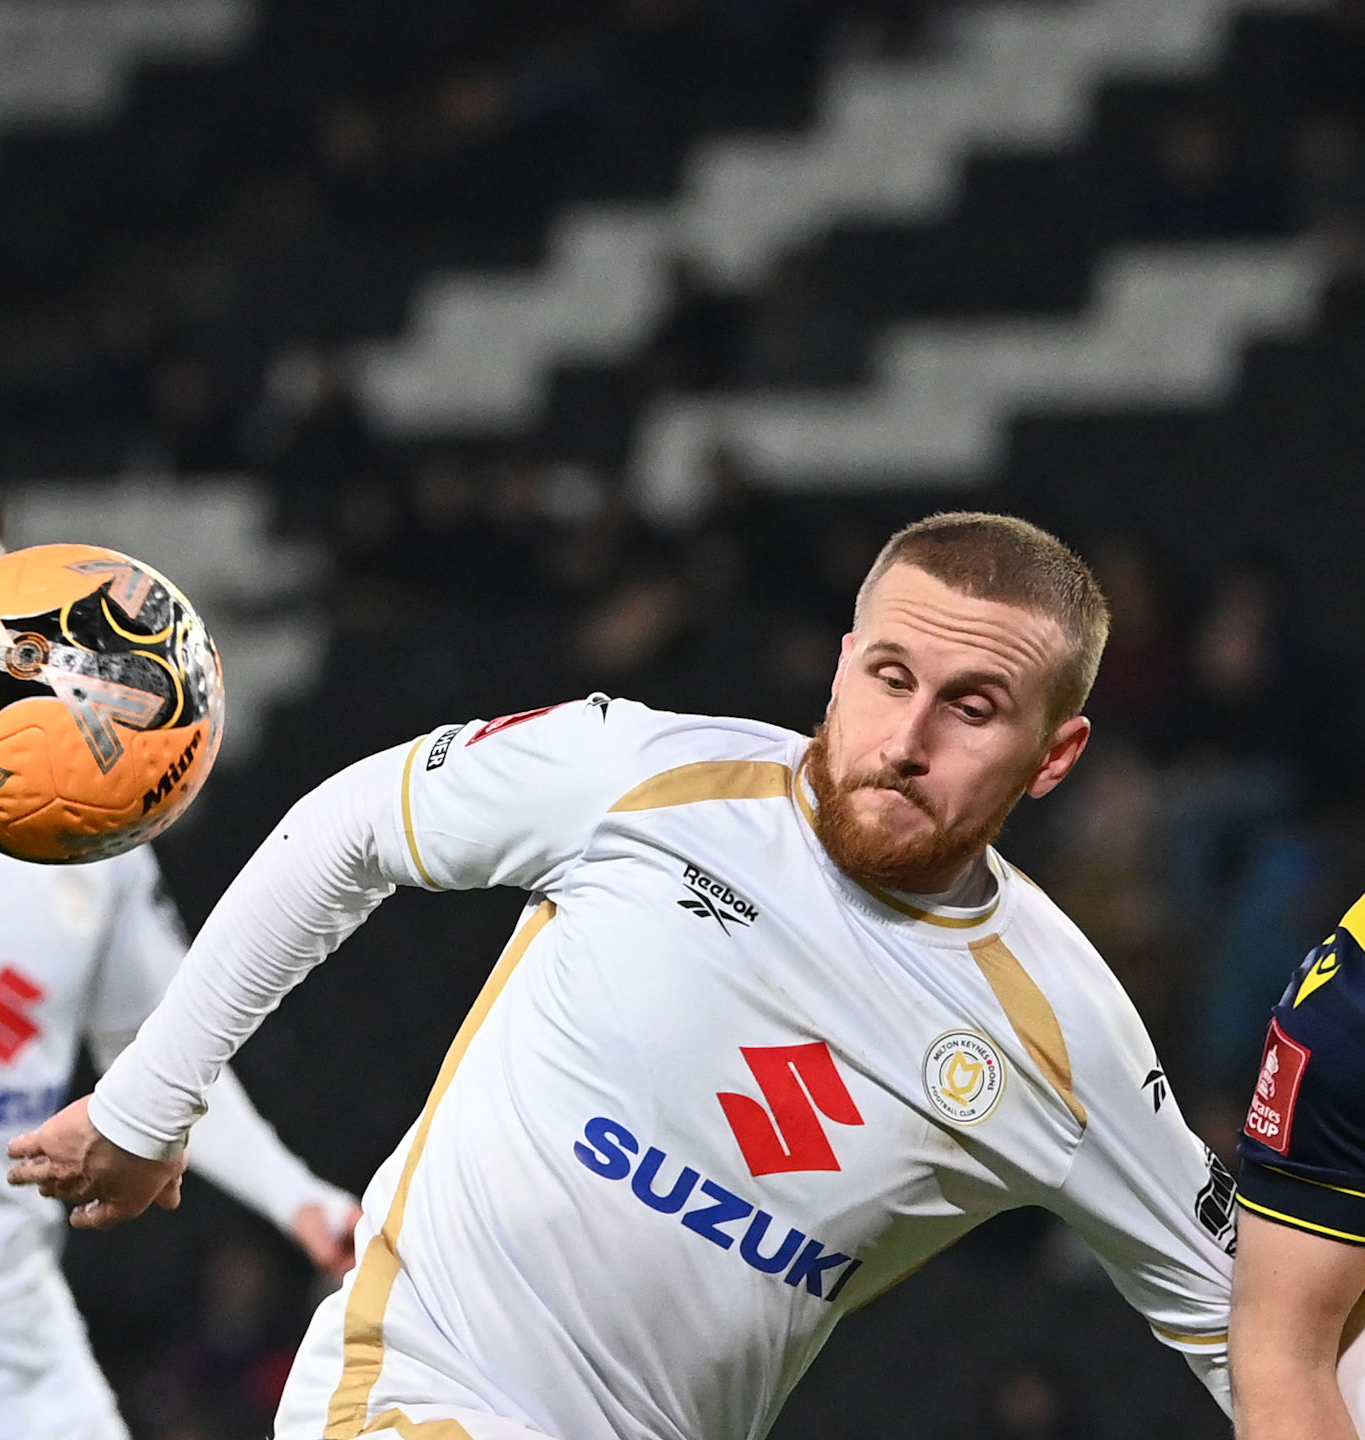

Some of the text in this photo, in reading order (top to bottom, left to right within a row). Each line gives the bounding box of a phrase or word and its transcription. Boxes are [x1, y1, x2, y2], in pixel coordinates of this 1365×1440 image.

[682, 863, 759, 922] Reebok
[933, 1040, 997, 1091] MILTON KEYNES DONS
[931, 1085, 958, 1117] FOOTBALL
[959, 1108, 977, 1118] CLUB
[1248, 1112, 1279, 1137] CUP
[573, 1116, 863, 1302] SUZUKI
